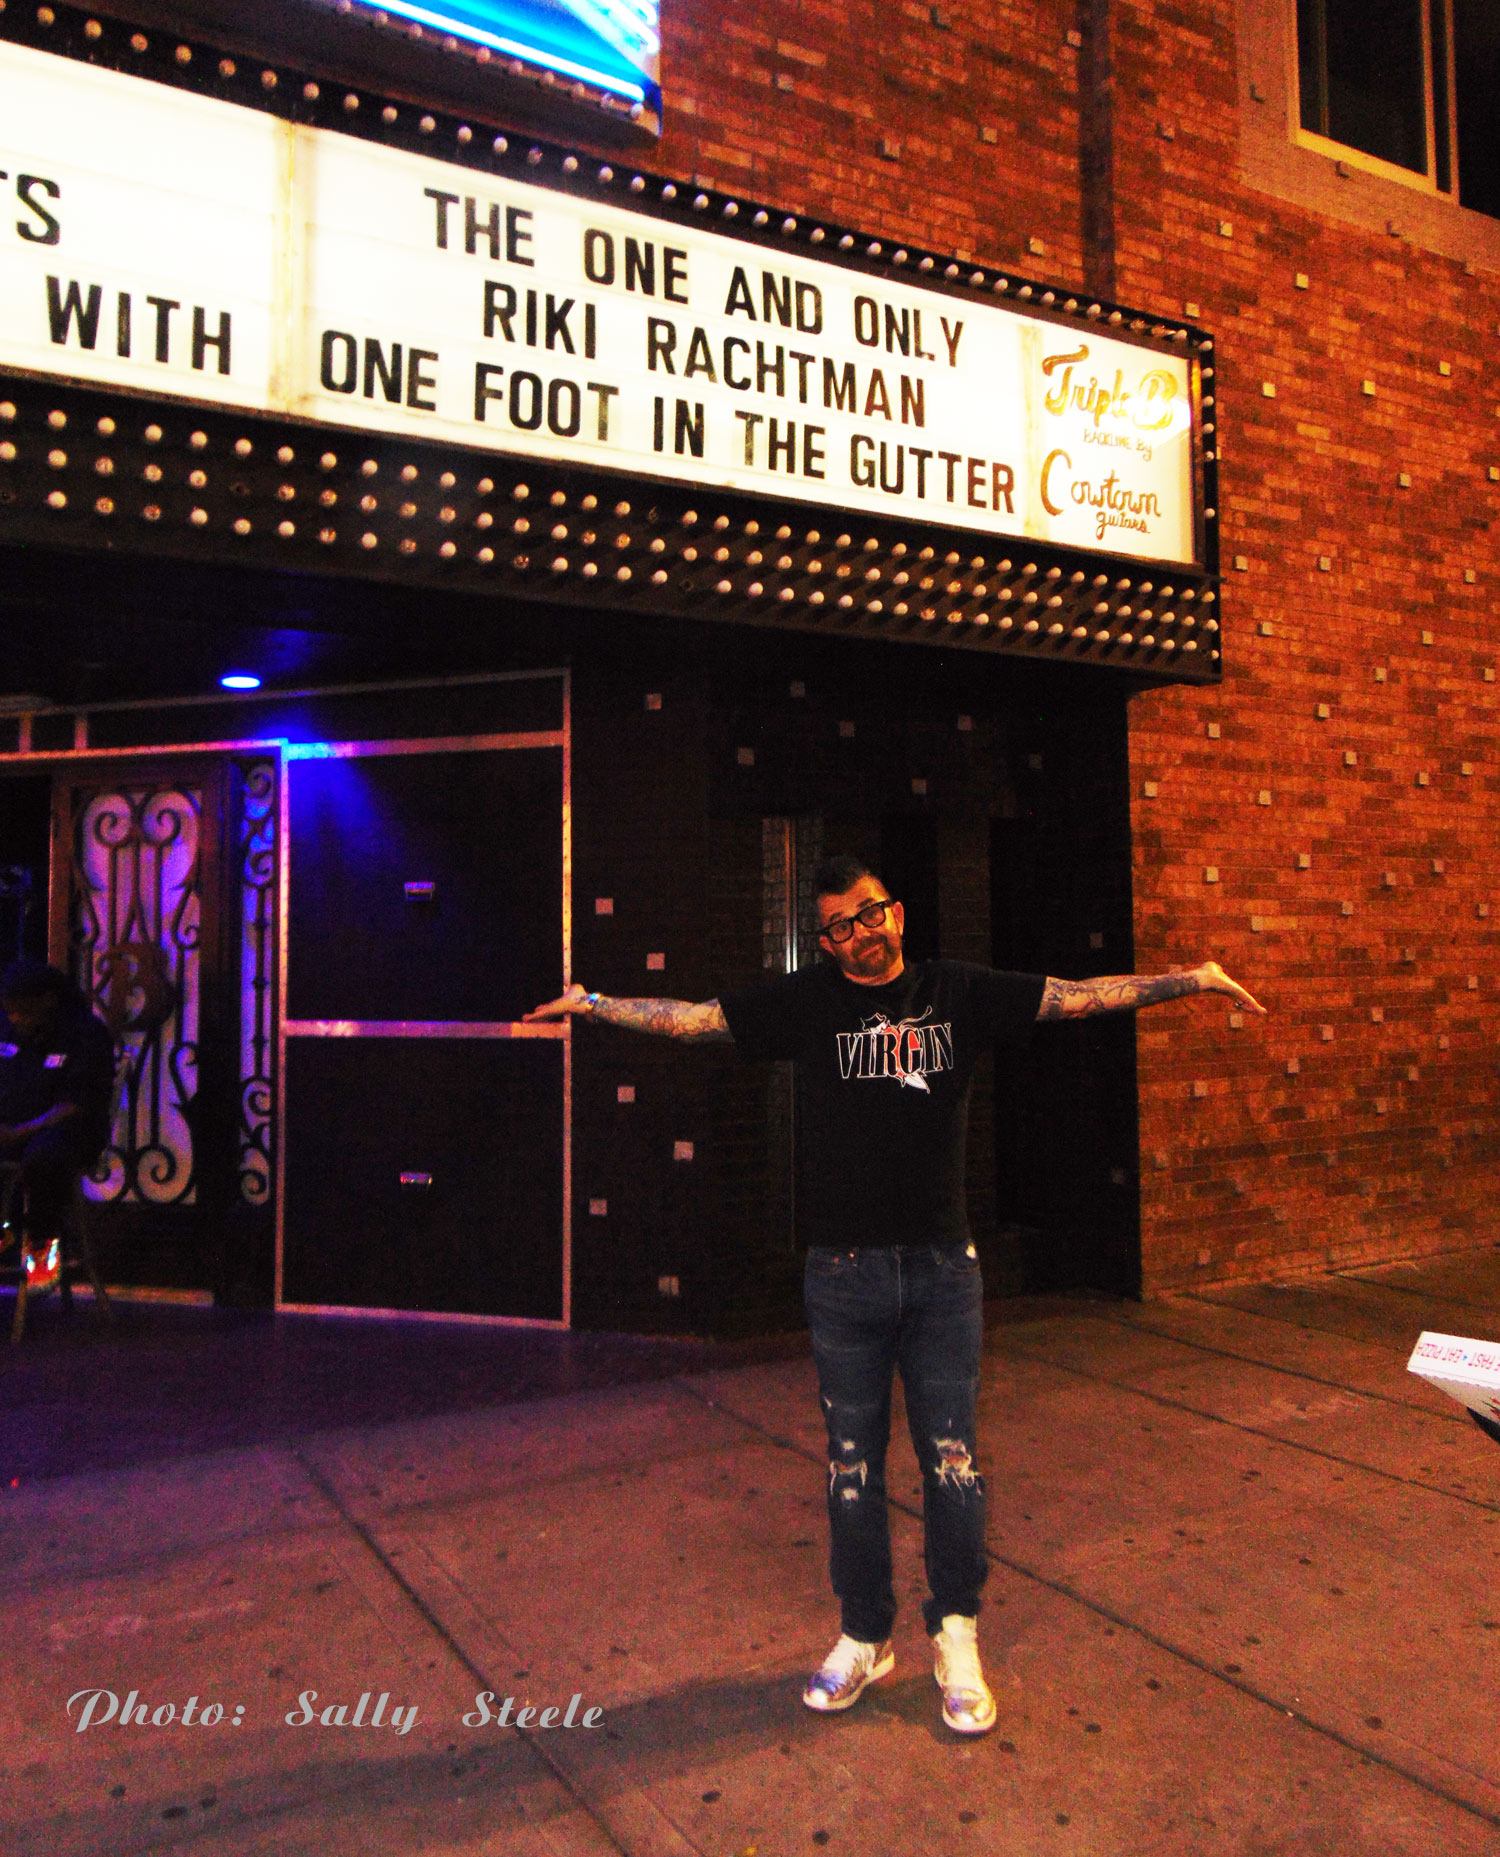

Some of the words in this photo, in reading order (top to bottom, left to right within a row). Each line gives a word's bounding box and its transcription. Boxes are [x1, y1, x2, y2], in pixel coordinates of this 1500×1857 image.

[0, 170, 60, 246] S
[423, 186, 535, 267] THE
[583, 228, 689, 305] ONE
[724, 266, 824, 335] AND
[853, 295, 964, 367] ONLY
[45, 275, 232, 376] WITH
[483, 280, 597, 360] RIKI
[647, 316, 926, 428] RACHTMAN
[320, 329, 439, 412] ONE
[474, 361, 619, 442] FOOT
[653, 396, 705, 458] IN
[734, 409, 826, 479] THE
[850, 434, 1015, 514] GUTTER
[1042, 344, 1131, 427] Triple
[1132, 369, 1178, 430] B
[1040, 448, 1161, 518] Cowtown
[836, 1022, 954, 1080] VIRGIN
